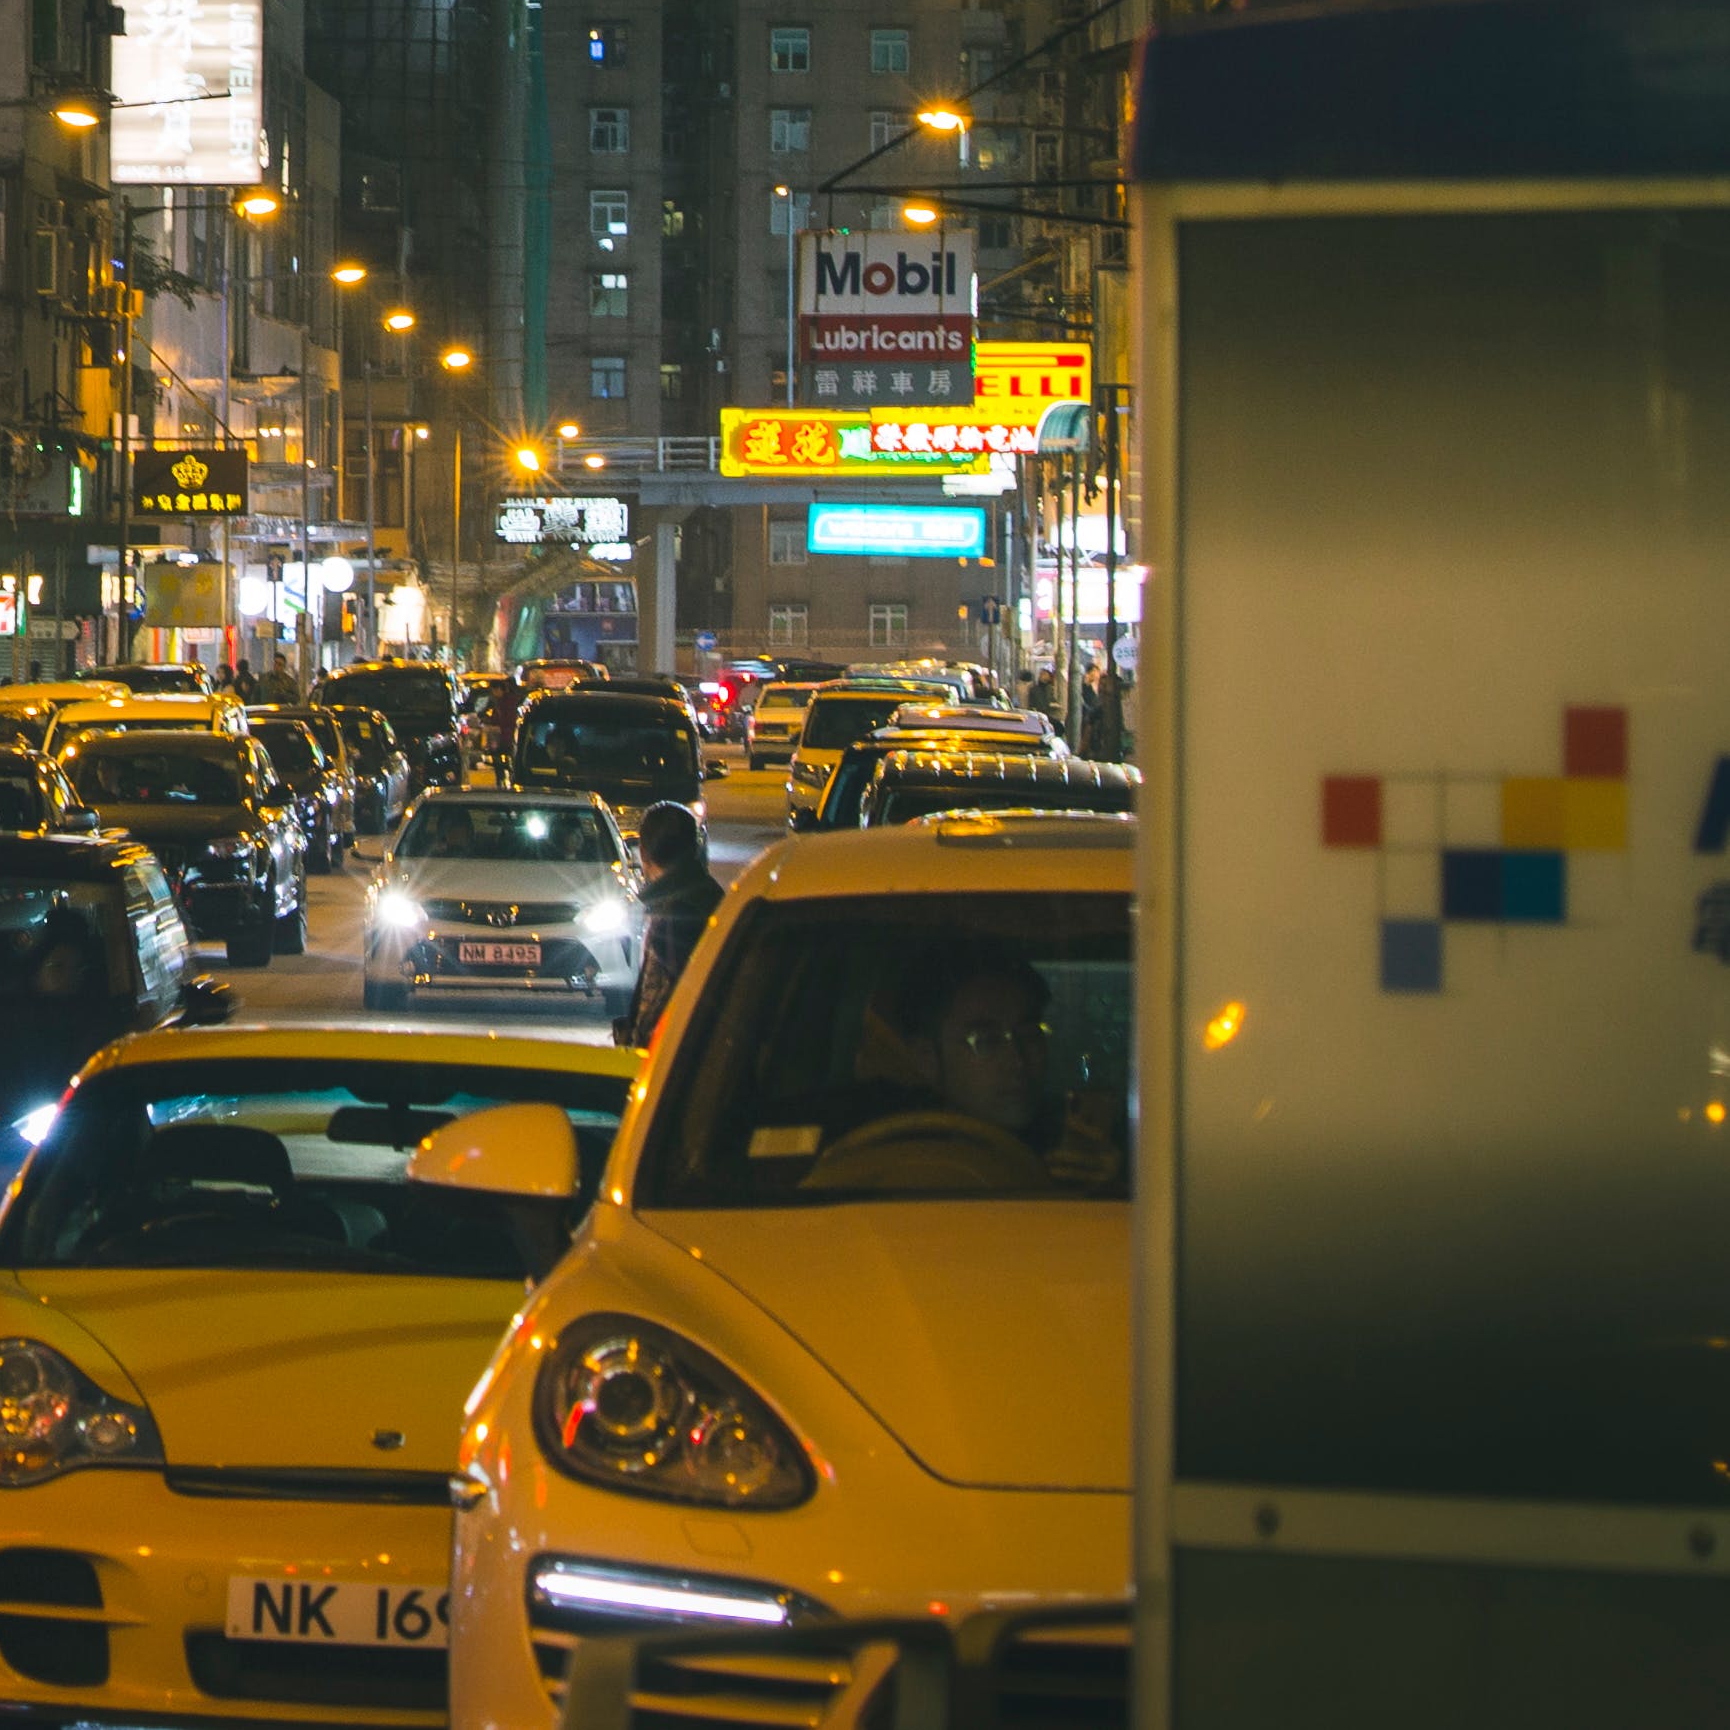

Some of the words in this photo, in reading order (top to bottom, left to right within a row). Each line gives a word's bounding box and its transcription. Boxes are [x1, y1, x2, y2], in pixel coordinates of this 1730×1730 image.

[817, 252, 955, 295] Mobil
[810, 325, 963, 350] Lubricants
[253, 1582, 337, 1637] NK
